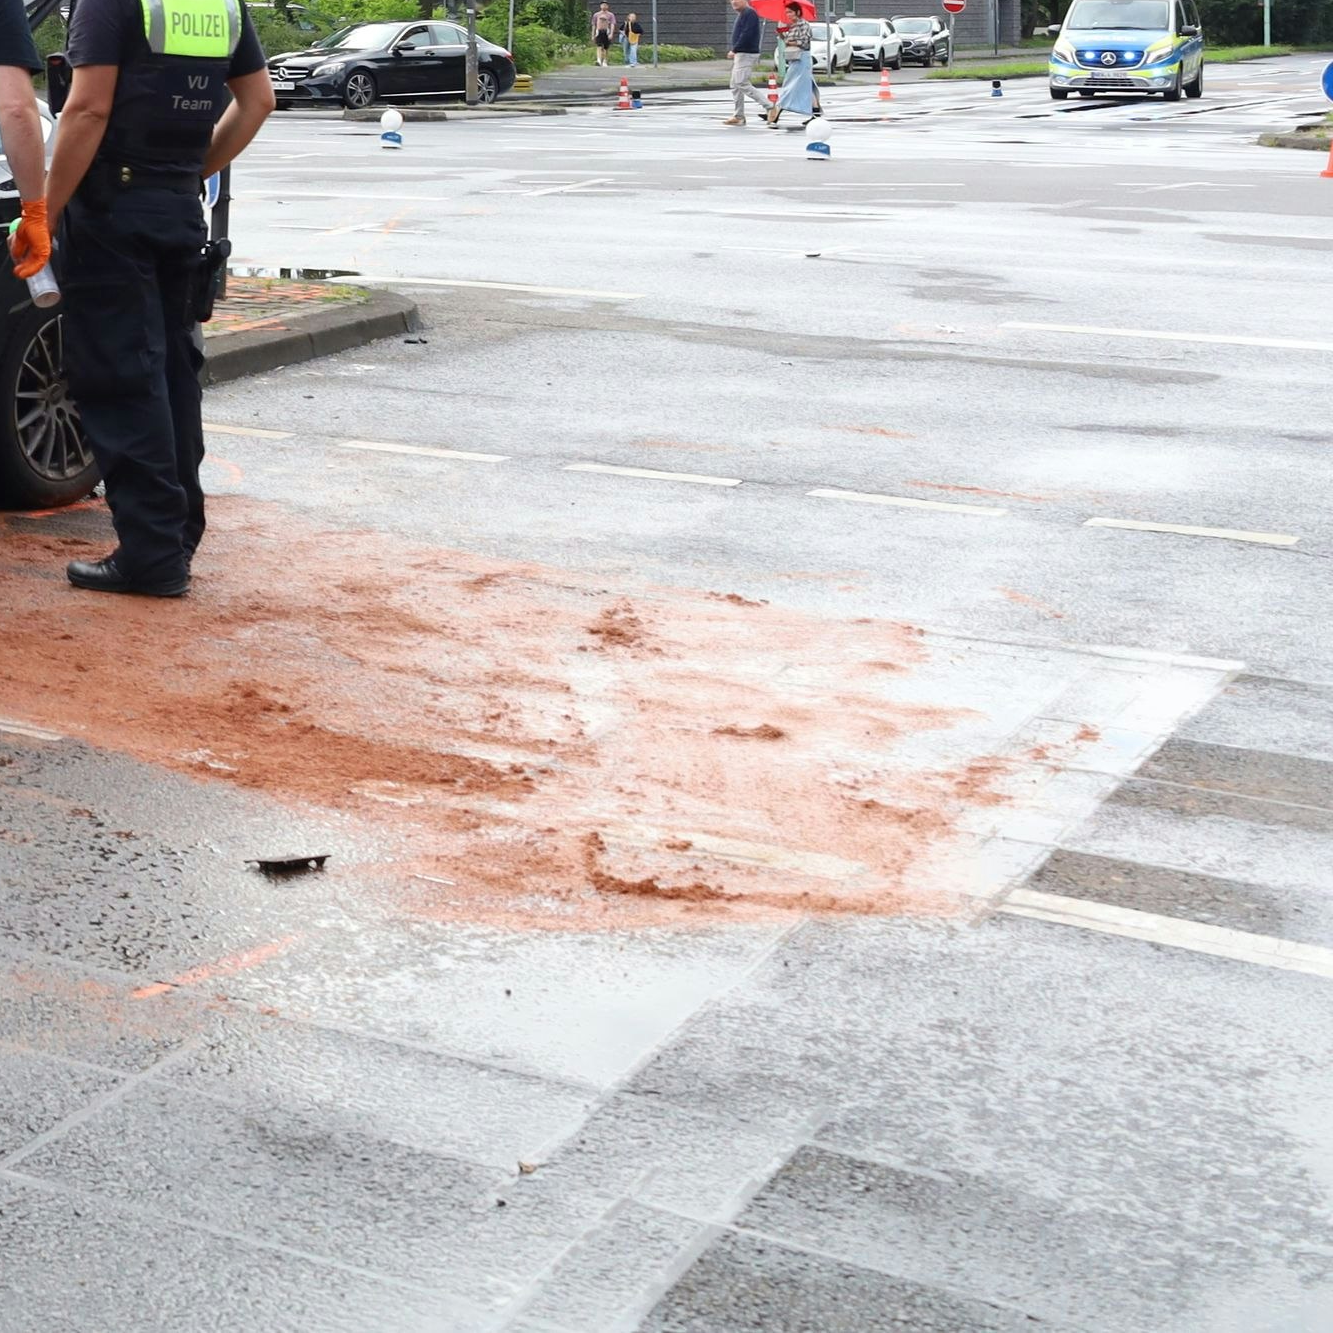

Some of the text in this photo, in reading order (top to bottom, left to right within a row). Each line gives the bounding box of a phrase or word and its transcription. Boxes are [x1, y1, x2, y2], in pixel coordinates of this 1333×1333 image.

[171, 12, 225, 38] POLIZEI
[187, 75, 210, 90] VU
[172, 94, 213, 111] Team
